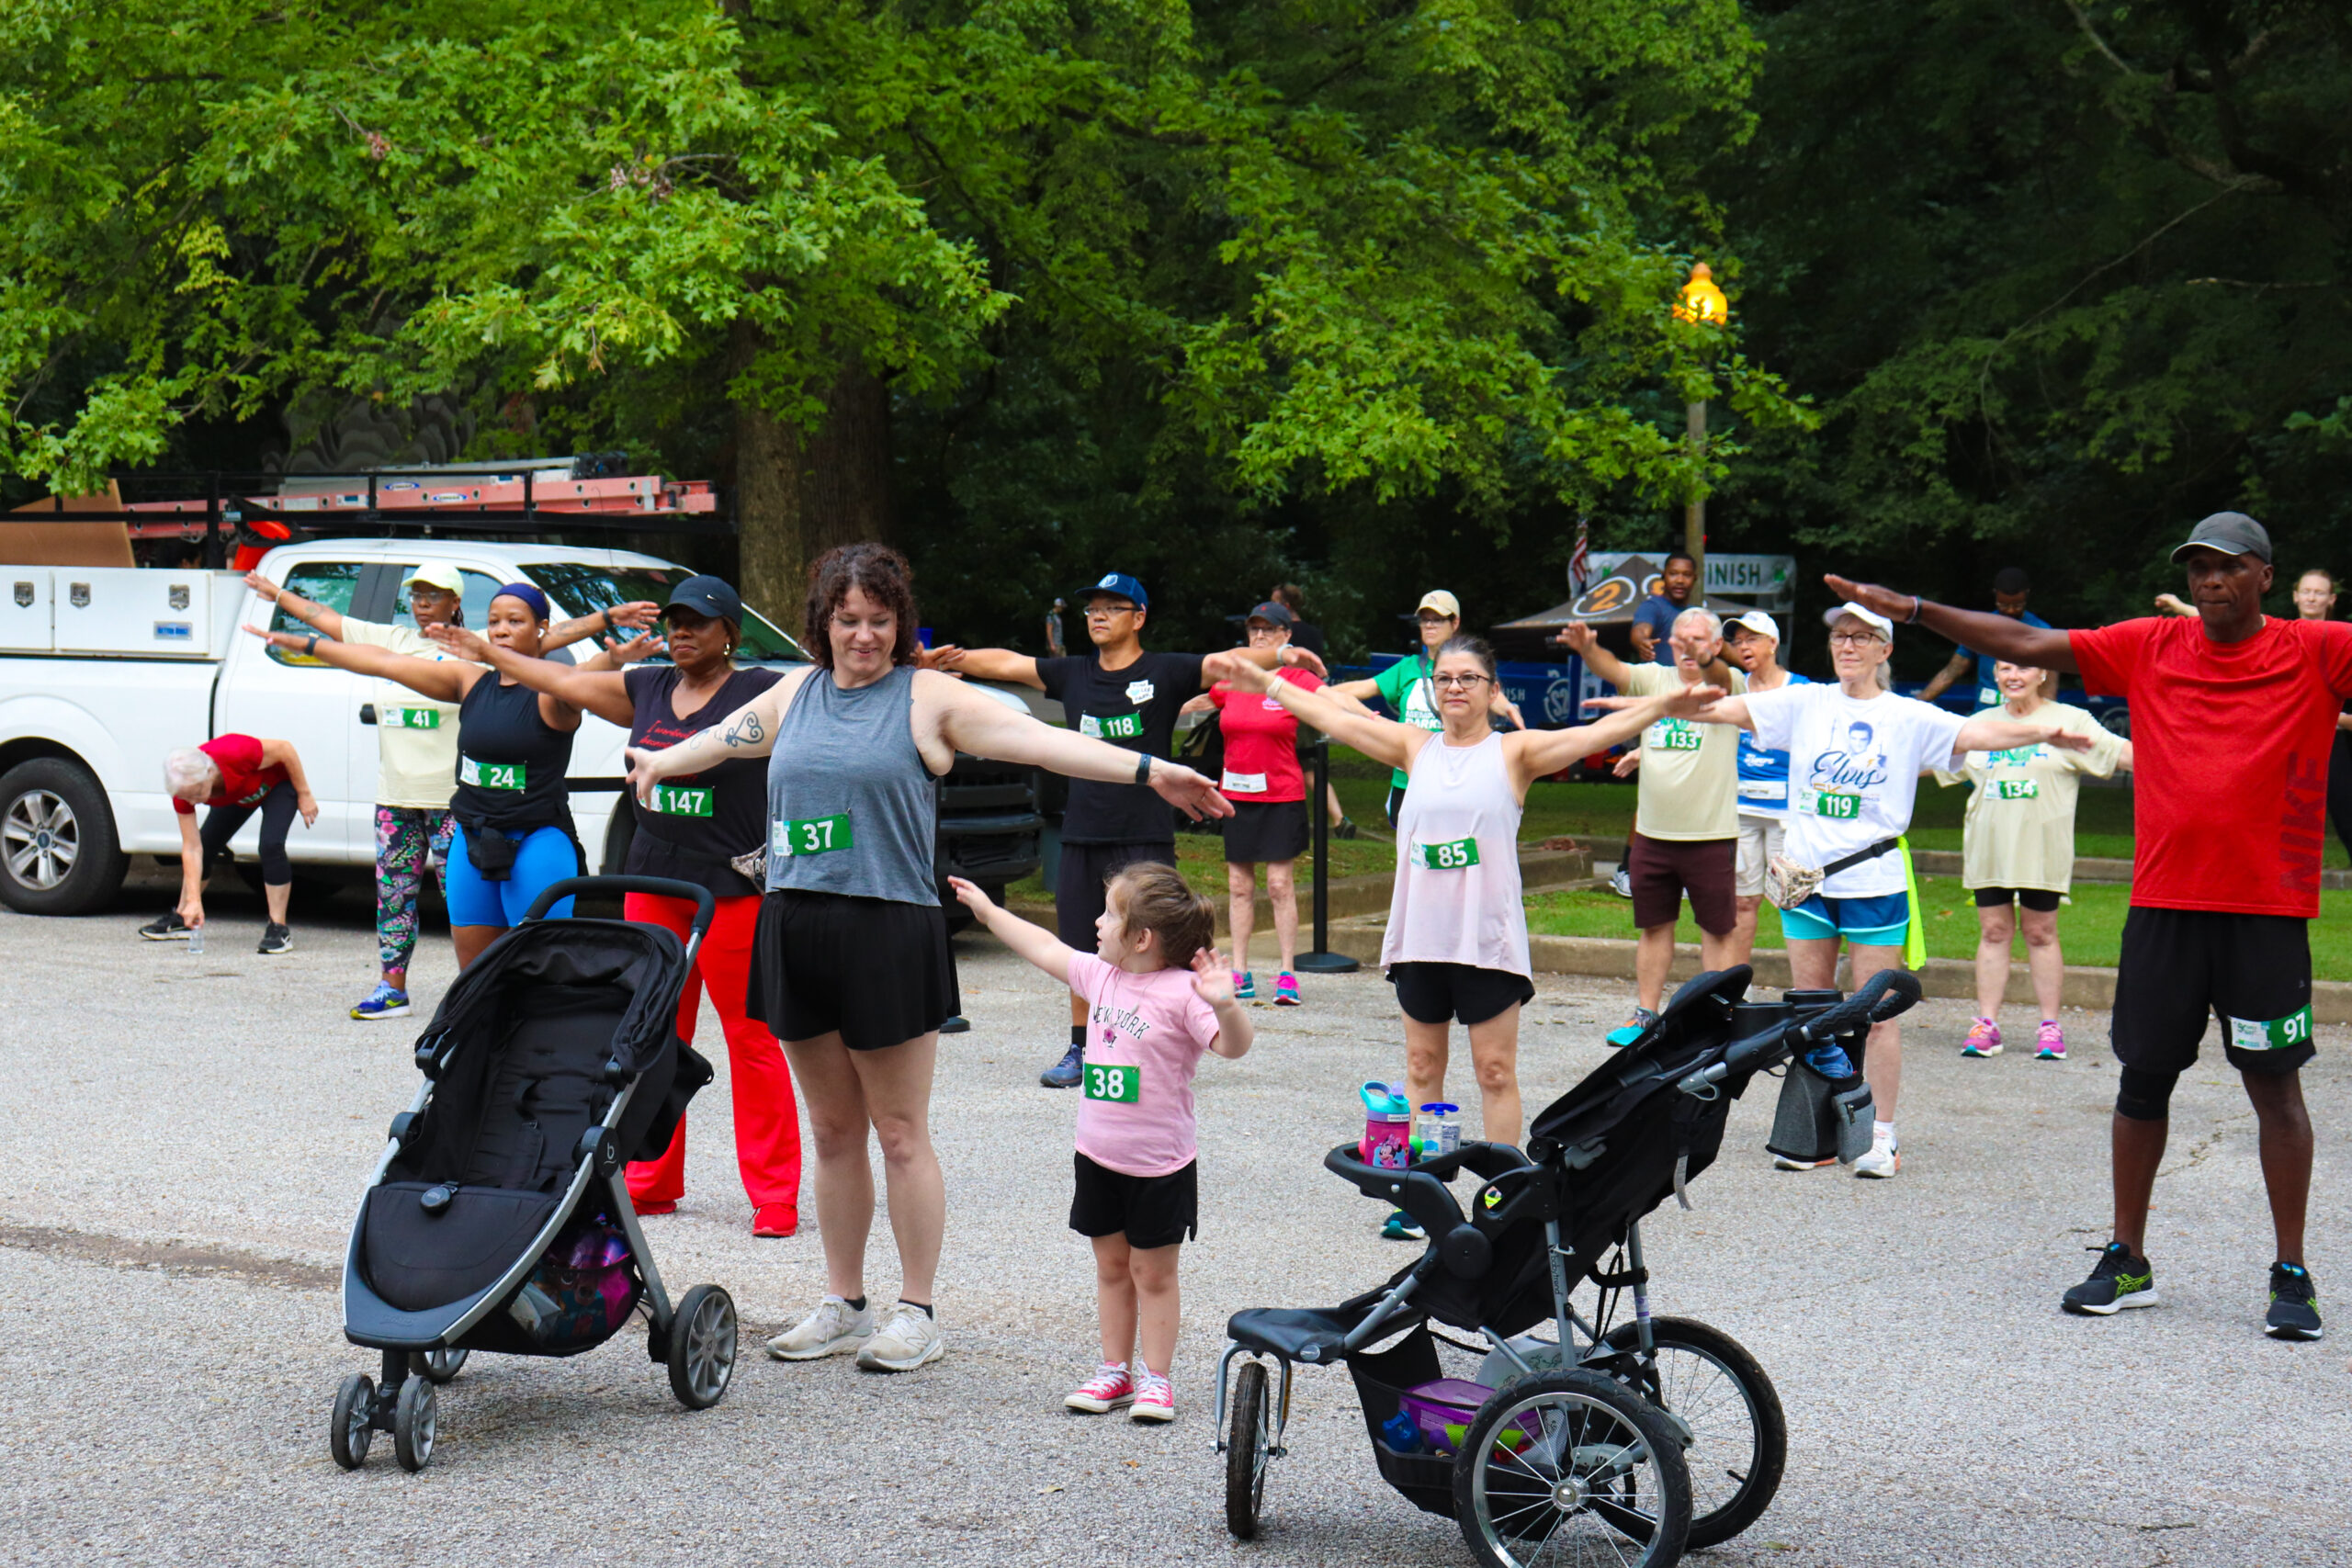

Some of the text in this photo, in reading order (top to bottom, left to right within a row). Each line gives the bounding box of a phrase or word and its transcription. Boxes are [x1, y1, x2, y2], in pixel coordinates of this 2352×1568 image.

[1707, 562, 1760, 586] INISH
[413, 710, 430, 727] 41
[1106, 716, 1135, 736] 118
[1670, 730, 1697, 749] 133
[490, 767, 515, 787] 24
[1810, 750, 1887, 789] Elvis
[2005, 780, 2033, 798] 134
[667, 790, 706, 814] 147
[1826, 795, 1853, 818] 119
[802, 819, 833, 851] 37
[2279, 751, 2328, 895] NIKE
[1438, 842, 1468, 867] 85
[1114, 1009, 1150, 1040] YORK
[2283, 1011, 2306, 1043] 97
[1092, 1067, 1125, 1099] 38
